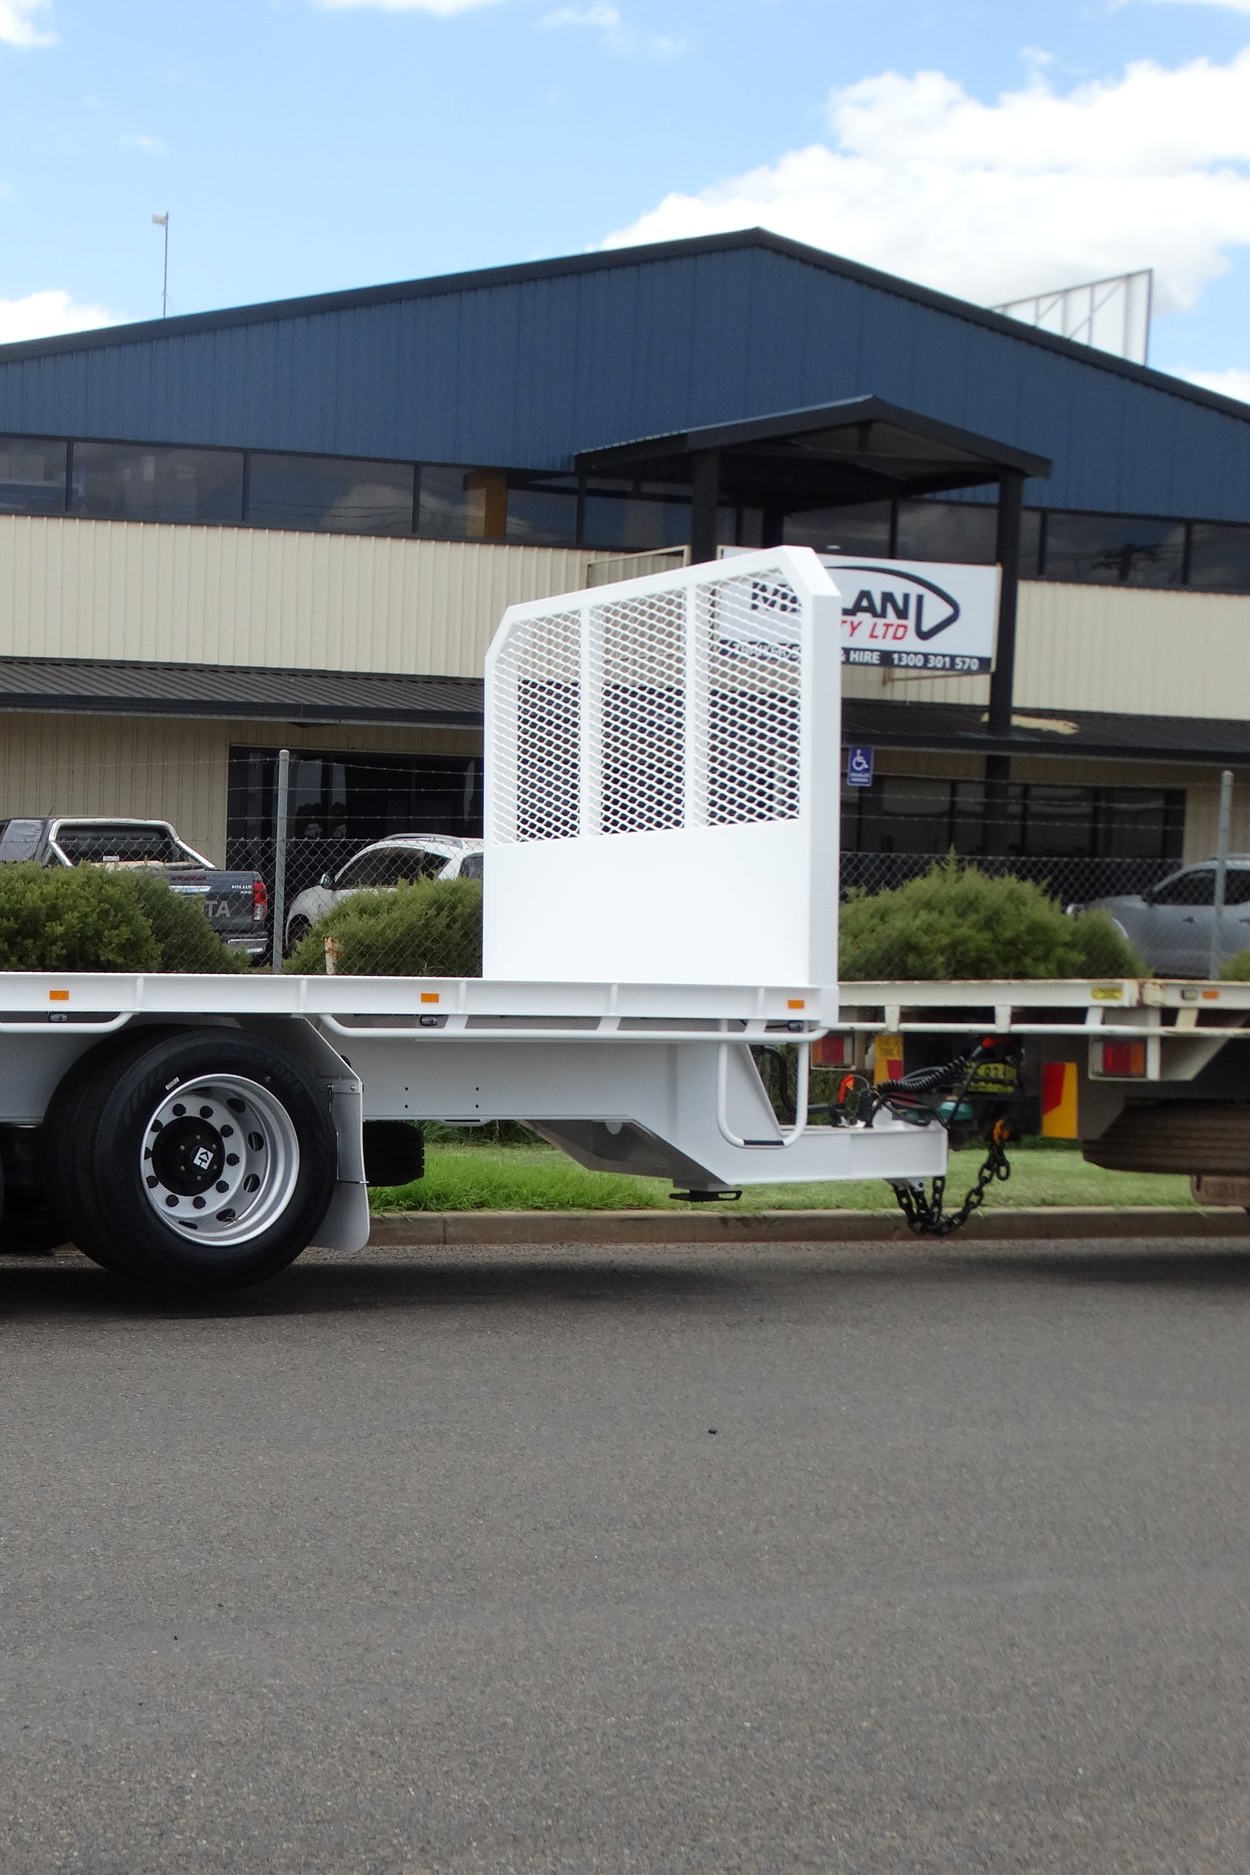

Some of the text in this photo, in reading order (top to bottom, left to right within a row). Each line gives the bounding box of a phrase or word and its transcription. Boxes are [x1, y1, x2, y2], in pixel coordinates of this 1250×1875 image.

[869, 622, 908, 640] LTD
[850, 650, 880, 664] HIRE
[892, 653, 924, 667] 1300
[927, 655, 950, 668] 301
[955, 657, 980, 671] 570
